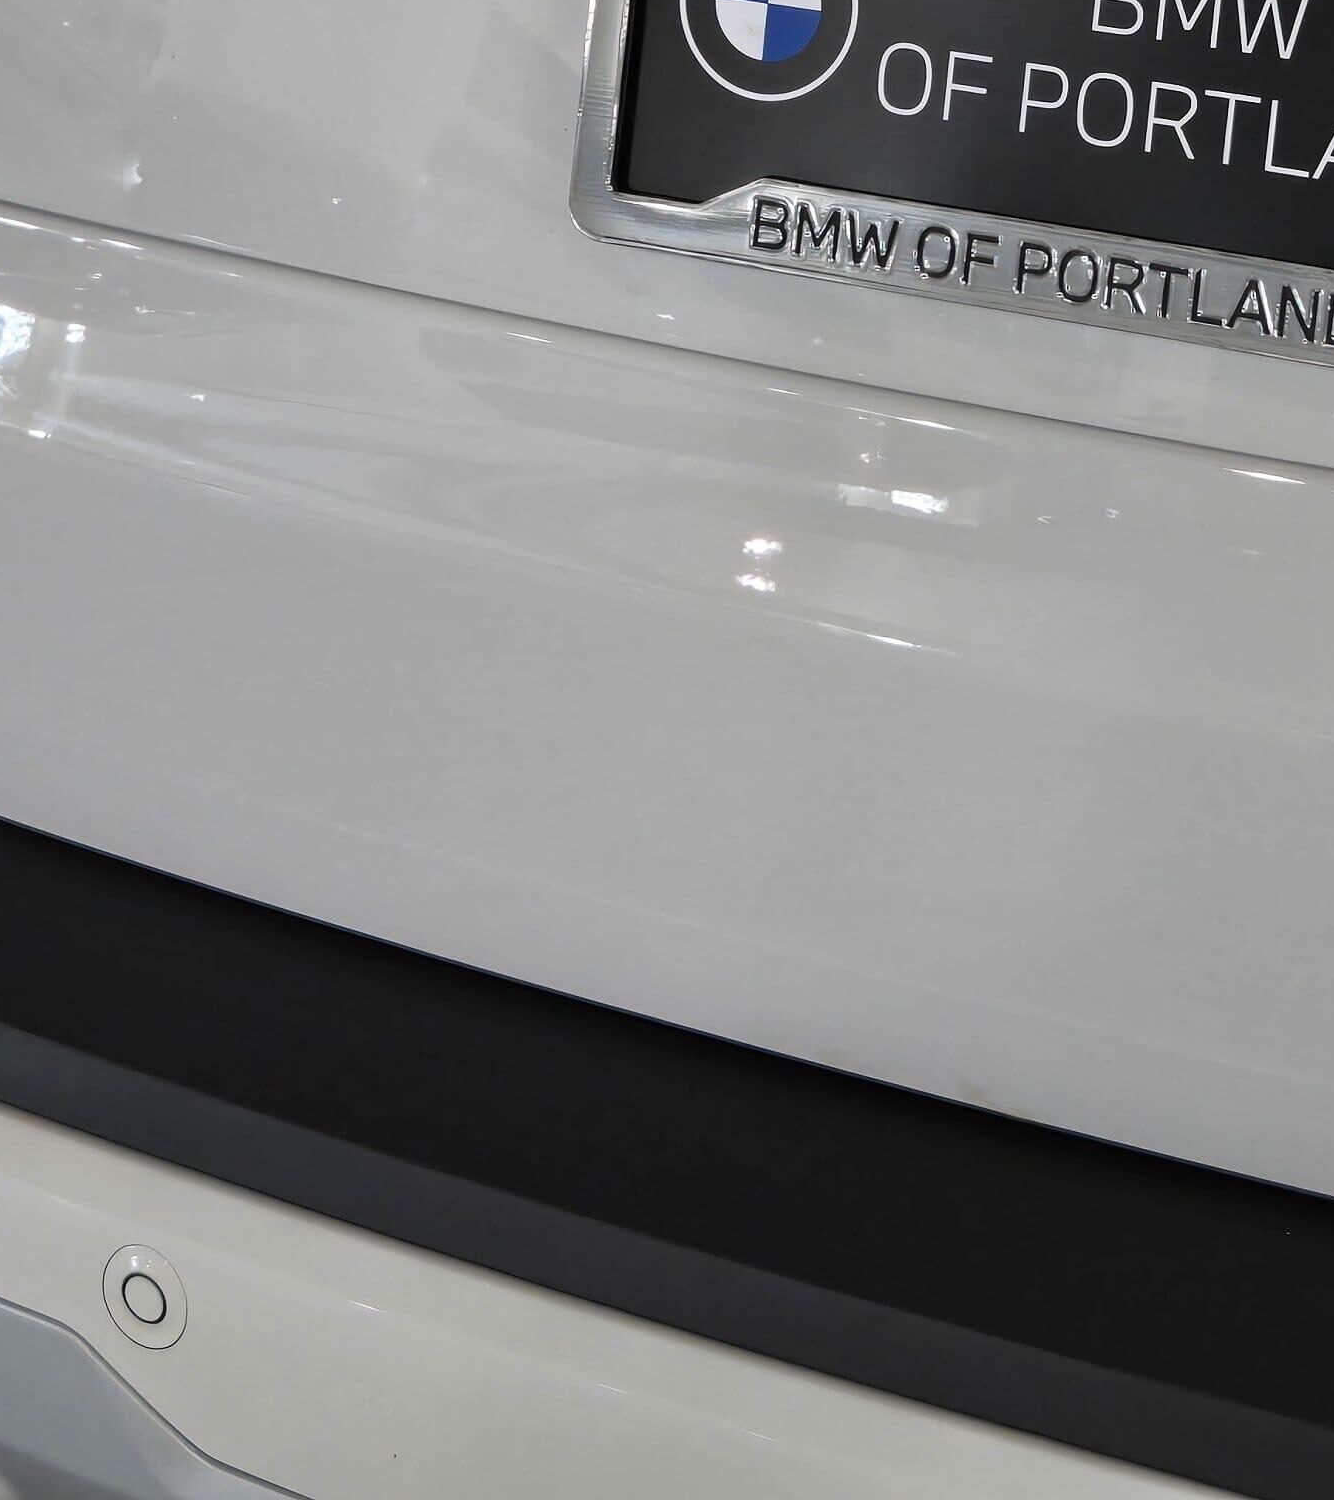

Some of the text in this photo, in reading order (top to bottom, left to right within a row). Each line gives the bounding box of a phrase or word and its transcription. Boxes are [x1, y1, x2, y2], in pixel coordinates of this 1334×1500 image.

[877, 42, 992, 121] OF
[749, 197, 900, 271] BMW
[914, 226, 1002, 286] OF
